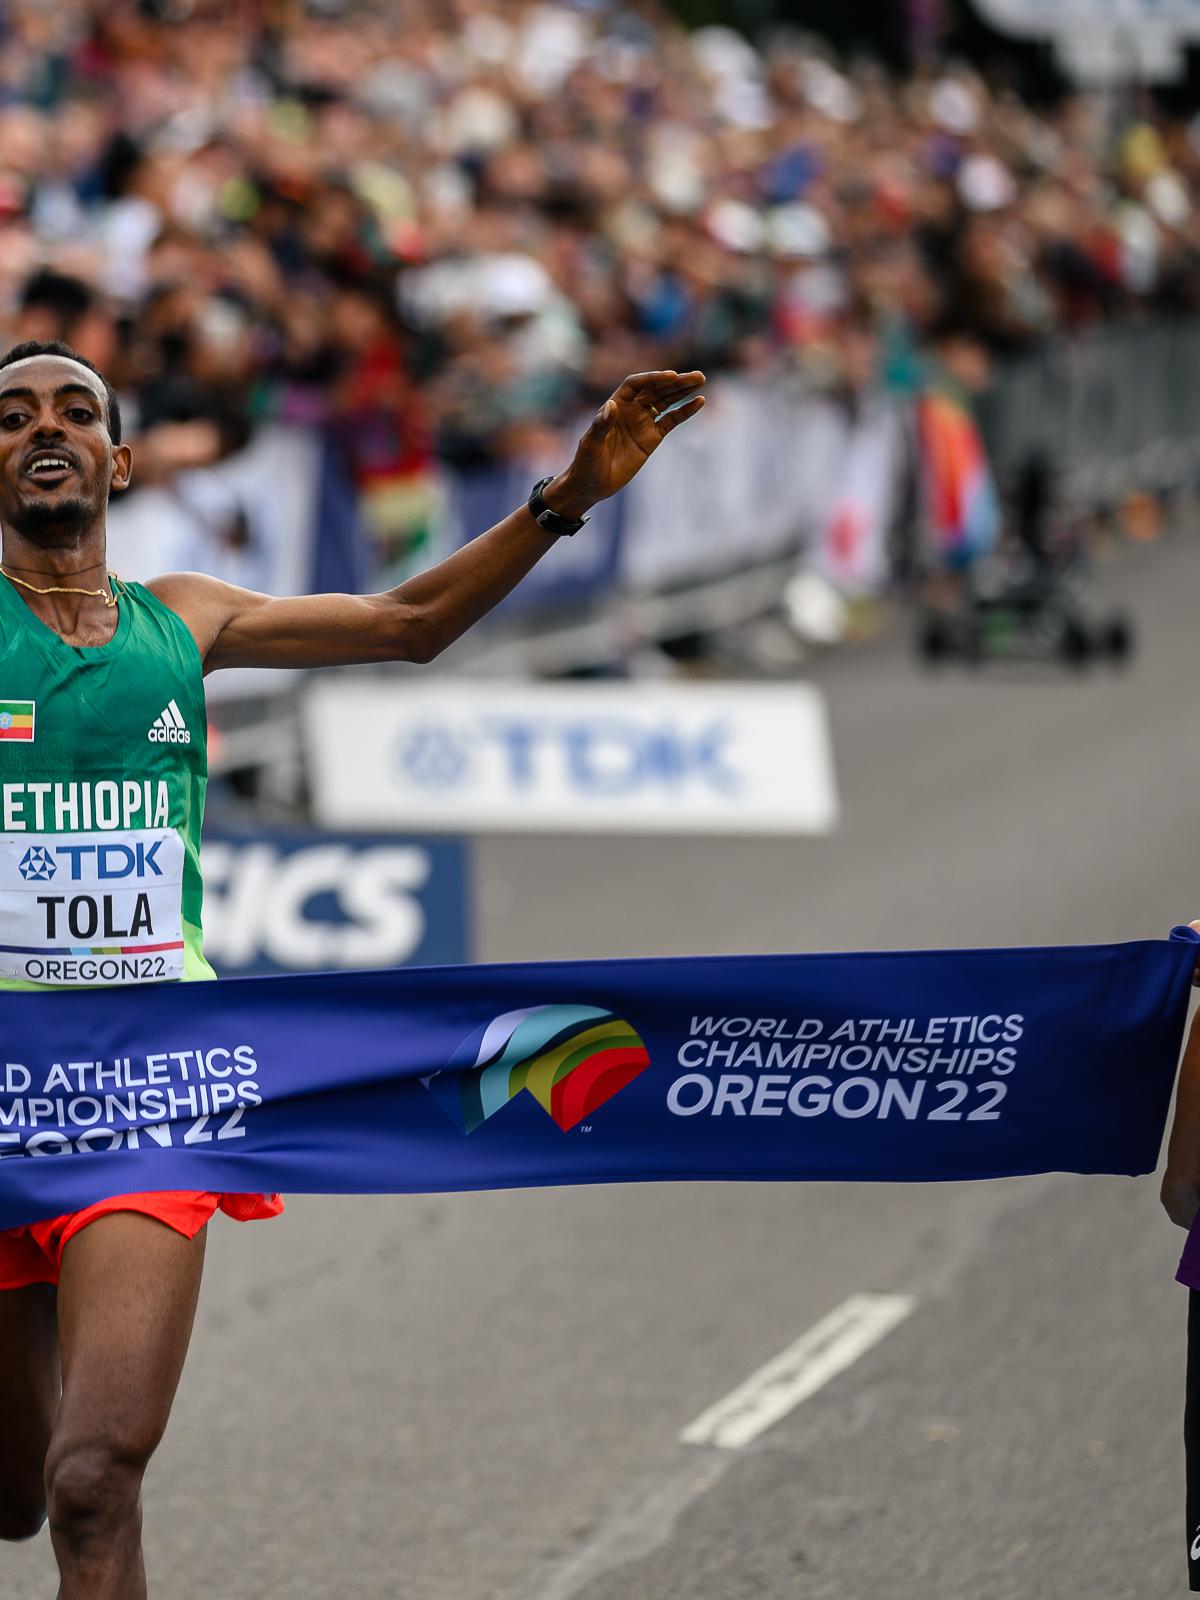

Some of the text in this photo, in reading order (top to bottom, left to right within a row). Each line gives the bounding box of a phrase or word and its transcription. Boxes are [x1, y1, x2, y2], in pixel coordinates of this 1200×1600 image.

[148, 727, 191, 744] adidas
[480, 712, 750, 800] TDK
[3, 780, 169, 831] ETHIOPIA
[55, 841, 163, 881] TDK
[37, 893, 154, 939] TOLA
[25, 957, 166, 981] OREGON22
[689, 1014, 1024, 1044] WORLD ATHLETICS
[43, 1045, 258, 1093] ATHLETICS
[677, 1040, 1017, 1075] CHAMPIONSHIPS
